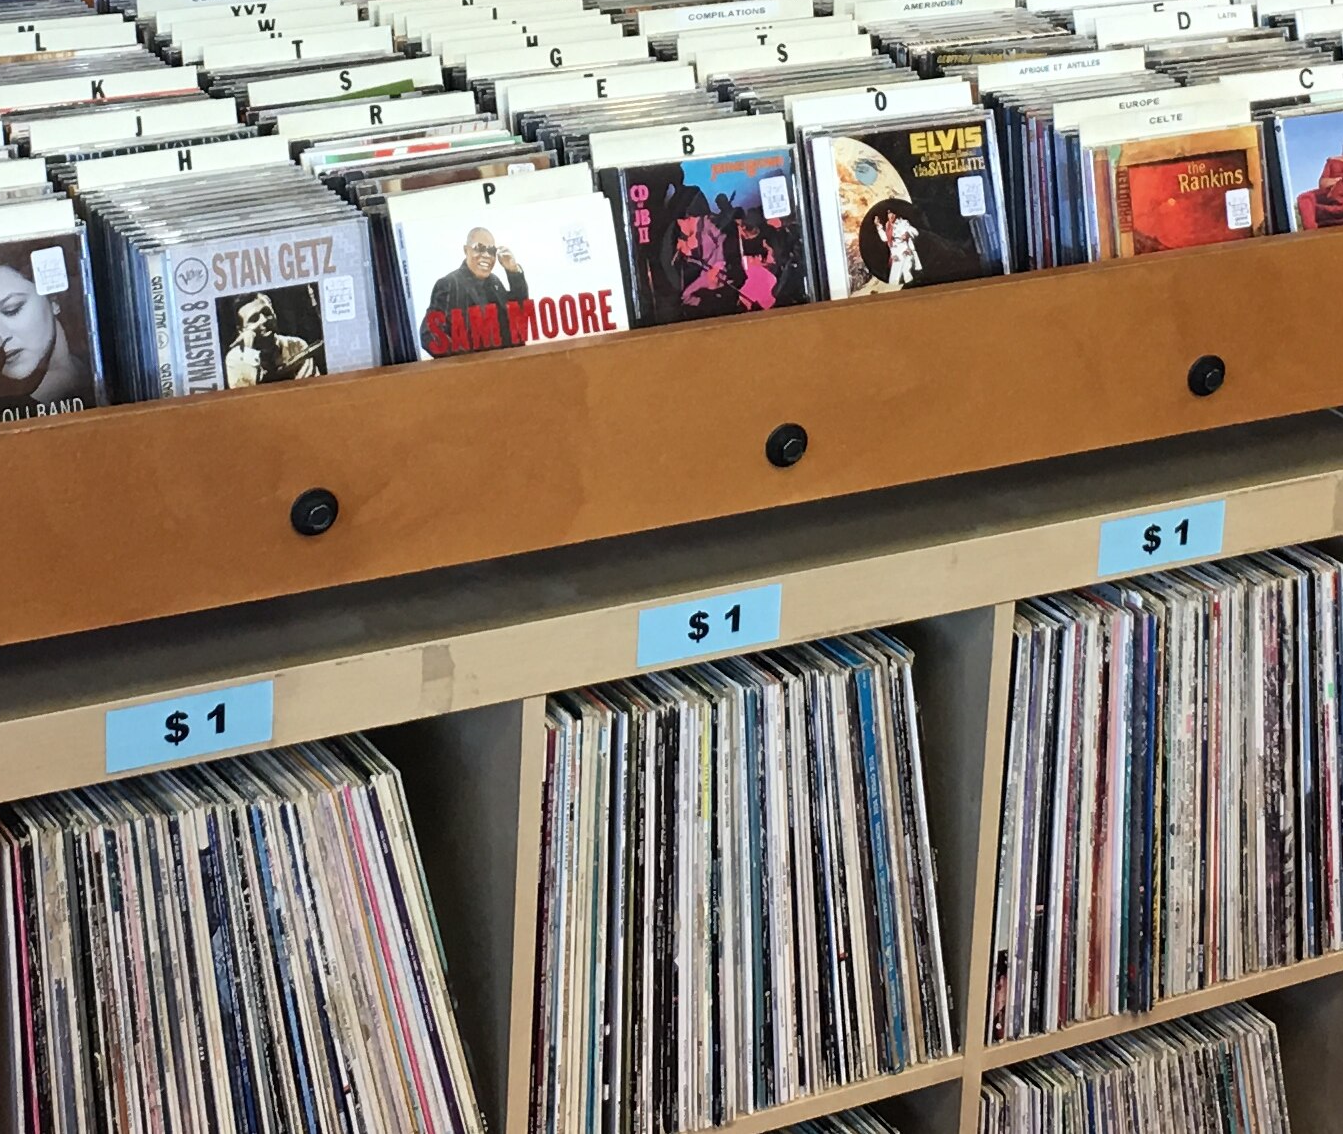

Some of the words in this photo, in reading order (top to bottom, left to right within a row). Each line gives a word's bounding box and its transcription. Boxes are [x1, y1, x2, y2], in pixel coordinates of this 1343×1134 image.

[688, 6, 766, 21] COMPILATIONS
[1119, 98, 1160, 110] EUROPE
[1149, 112, 1183, 125] CELTE
[910, 127, 982, 155] ELVIS
[928, 157, 985, 177] SATELLITE
[1178, 167, 1243, 193] Rankins
[1187, 162, 1206, 175] the
[212, 246, 271, 291] STAN
[278, 236, 336, 281] GETZ
[181, 301, 209, 311] 8
[426, 304, 502, 356] SAM
[505, 289, 618, 349] MOORE
[184, 313, 217, 383] MASTERS
[1142, 524, 1162, 554] $
[1175, 519, 1190, 546] 1
[688, 610, 710, 643] $
[724, 604, 741, 633] 1
[163, 710, 190, 747] $
[206, 703, 228, 735] 1
